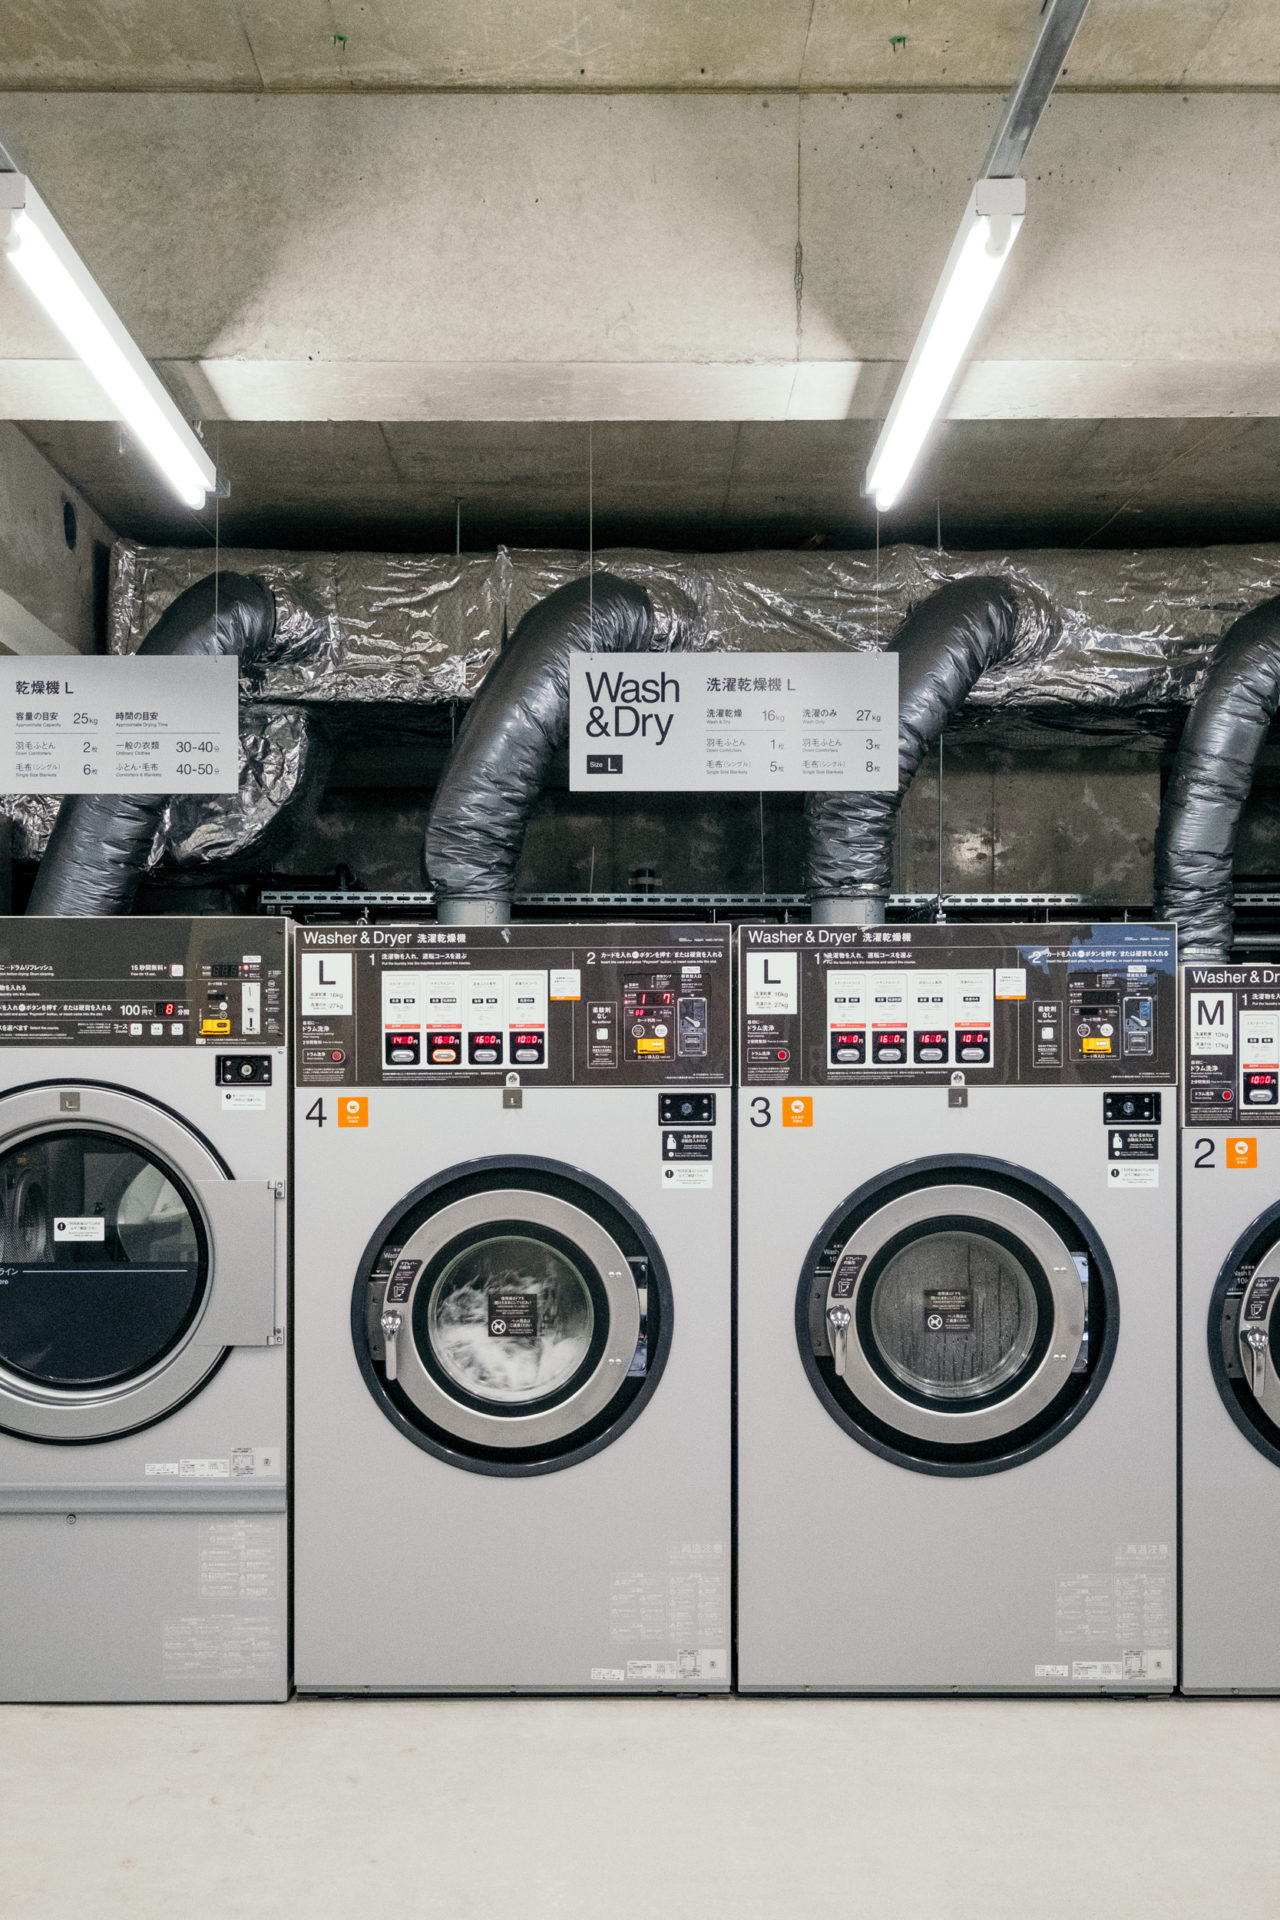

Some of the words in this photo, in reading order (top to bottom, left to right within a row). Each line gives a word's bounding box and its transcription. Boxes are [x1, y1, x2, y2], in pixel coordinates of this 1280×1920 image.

[16, 680, 60, 695] 乾燥機
[65, 682, 74, 694] L
[585, 671, 680, 703] Wash
[706, 677, 781, 692] 洗濯乾燥機
[787, 679, 796, 691] L
[16, 712, 58, 721] 容量の目安
[73, 712, 98, 725] 25kg
[116, 712, 158, 721] 時間の目安
[706, 709, 742, 718] 洗濯乾燥
[762, 710, 785, 723] 16kg
[802, 709, 837, 718] 洗濯のみ
[856, 709, 881, 723] 27kg
[586, 706, 674, 746] &Dry
[16, 741, 56, 750] 羽毛ふとん
[116, 741, 160, 750] 一般の衣類
[706, 738, 747, 747] 羽毛ふとん
[802, 738, 843, 747] 羽毛ふとん
[116, 763, 159, 772] ふとん・毛布
[589, 761, 603, 769] Size
[608, 758, 618, 772] L
[303, 931, 357, 945] Washer
[360, 932, 370, 945] &
[373, 931, 412, 947] Dryer
[417, 933, 467, 943] 洗濯乾燥機
[748, 930, 802, 944] Washer
[805, 931, 815, 944] &
[818, 930, 857, 946] Dryer
[862, 932, 912, 943] 洗濯乾燥機
[369, 953, 375, 966] 1
[586, 951, 596, 965] 2
[814, 952, 820, 965] 1
[1031, 951, 1041, 964] 2
[319, 960, 336, 985] L
[763, 959, 781, 985] L
[1192, 970, 1247, 984] Washer
[1250, 971, 1260, 984] &
[1241, 993, 1248, 1006] 1
[165, 1003, 174, 1015] 8
[1197, 1000, 1224, 1025] M
[305, 1097, 327, 1128] 4
[750, 1096, 771, 1128] 3
[1194, 1137, 1216, 1169] 2
